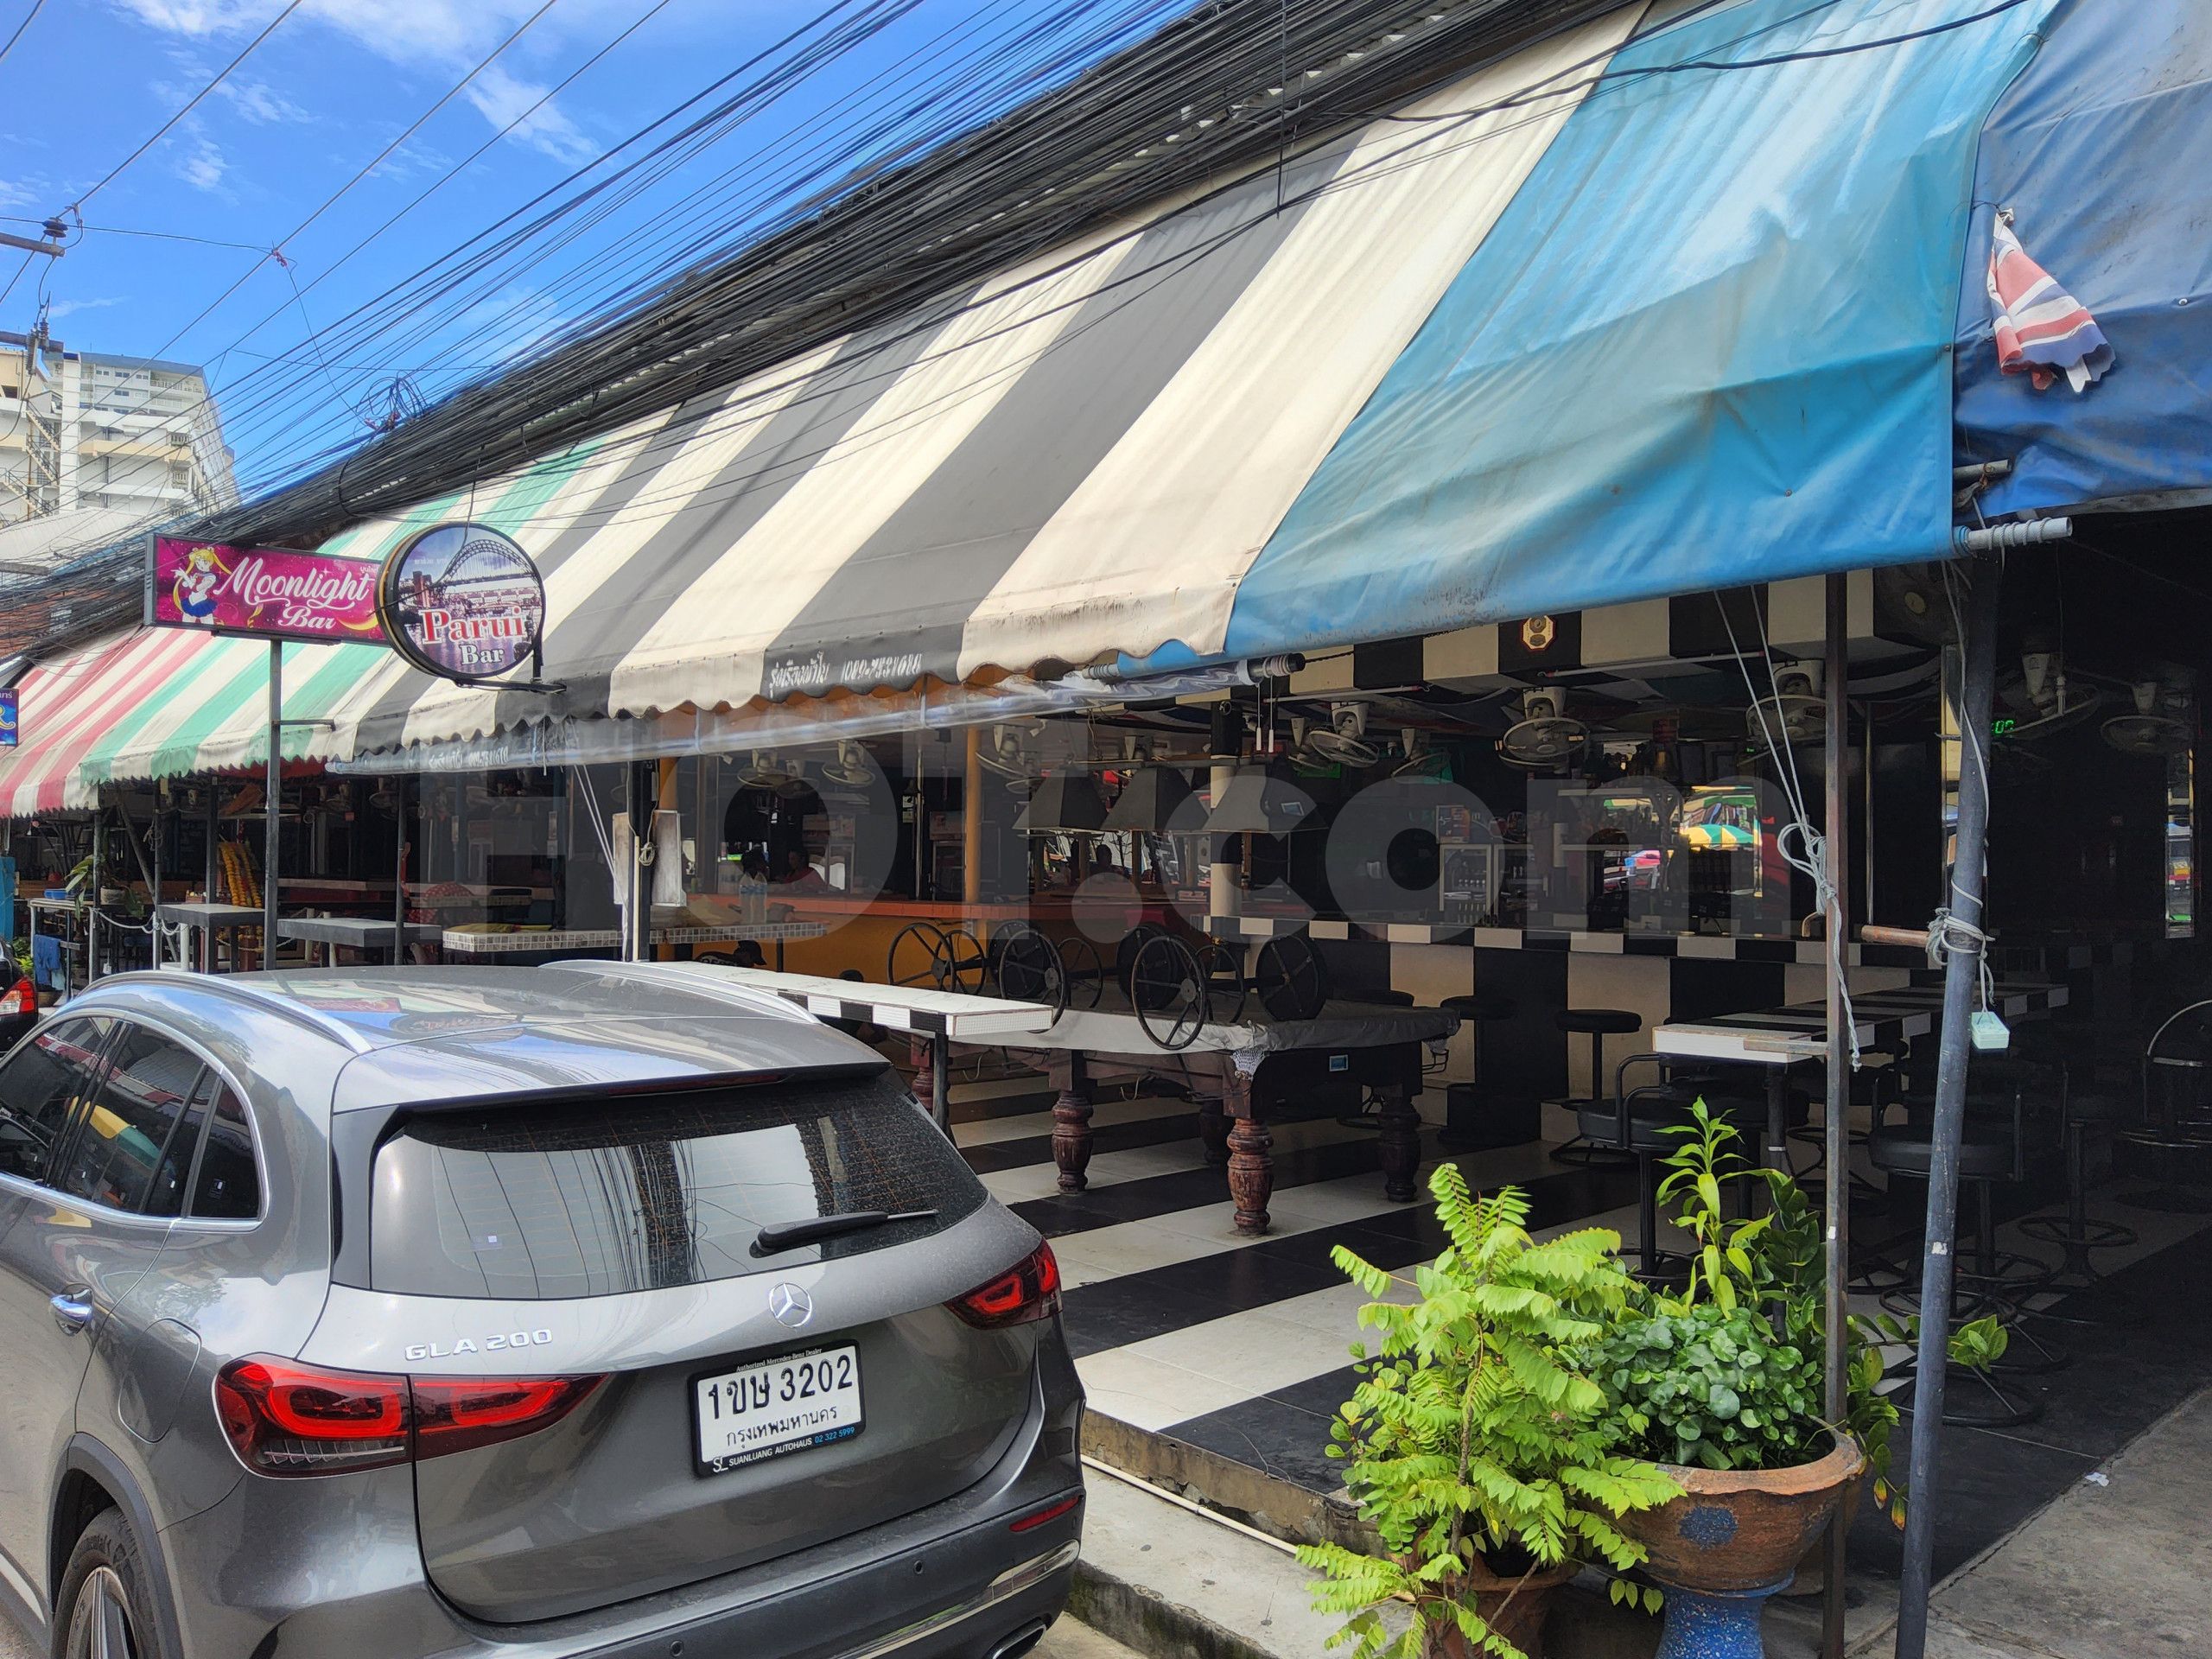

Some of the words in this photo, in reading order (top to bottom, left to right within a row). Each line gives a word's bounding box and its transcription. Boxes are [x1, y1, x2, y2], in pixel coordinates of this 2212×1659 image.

[213, 556, 375, 609] Moonlight
[278, 605, 335, 630] Bar
[418, 606, 528, 645] Parui
[459, 644, 505, 664] Bar
[404, 1338, 479, 1361] GLA
[486, 1329, 553, 1351] 200
[736, 1360, 766, 1372] Authorized
[766, 1351, 804, 1366] Mercedes-Benz
[805, 1347, 823, 1356] Dealer
[780, 1354, 854, 1402] 3202
[727, 1406, 837, 1448] กรุงเทพมหานคร
[728, 1447, 773, 1466] SUANLUANG
[774, 1437, 812, 1455] AUTOHAUS
[814, 1434, 823, 1445] 02
[823, 1431, 837, 1442] 322
[838, 1426, 855, 1438] 5999
